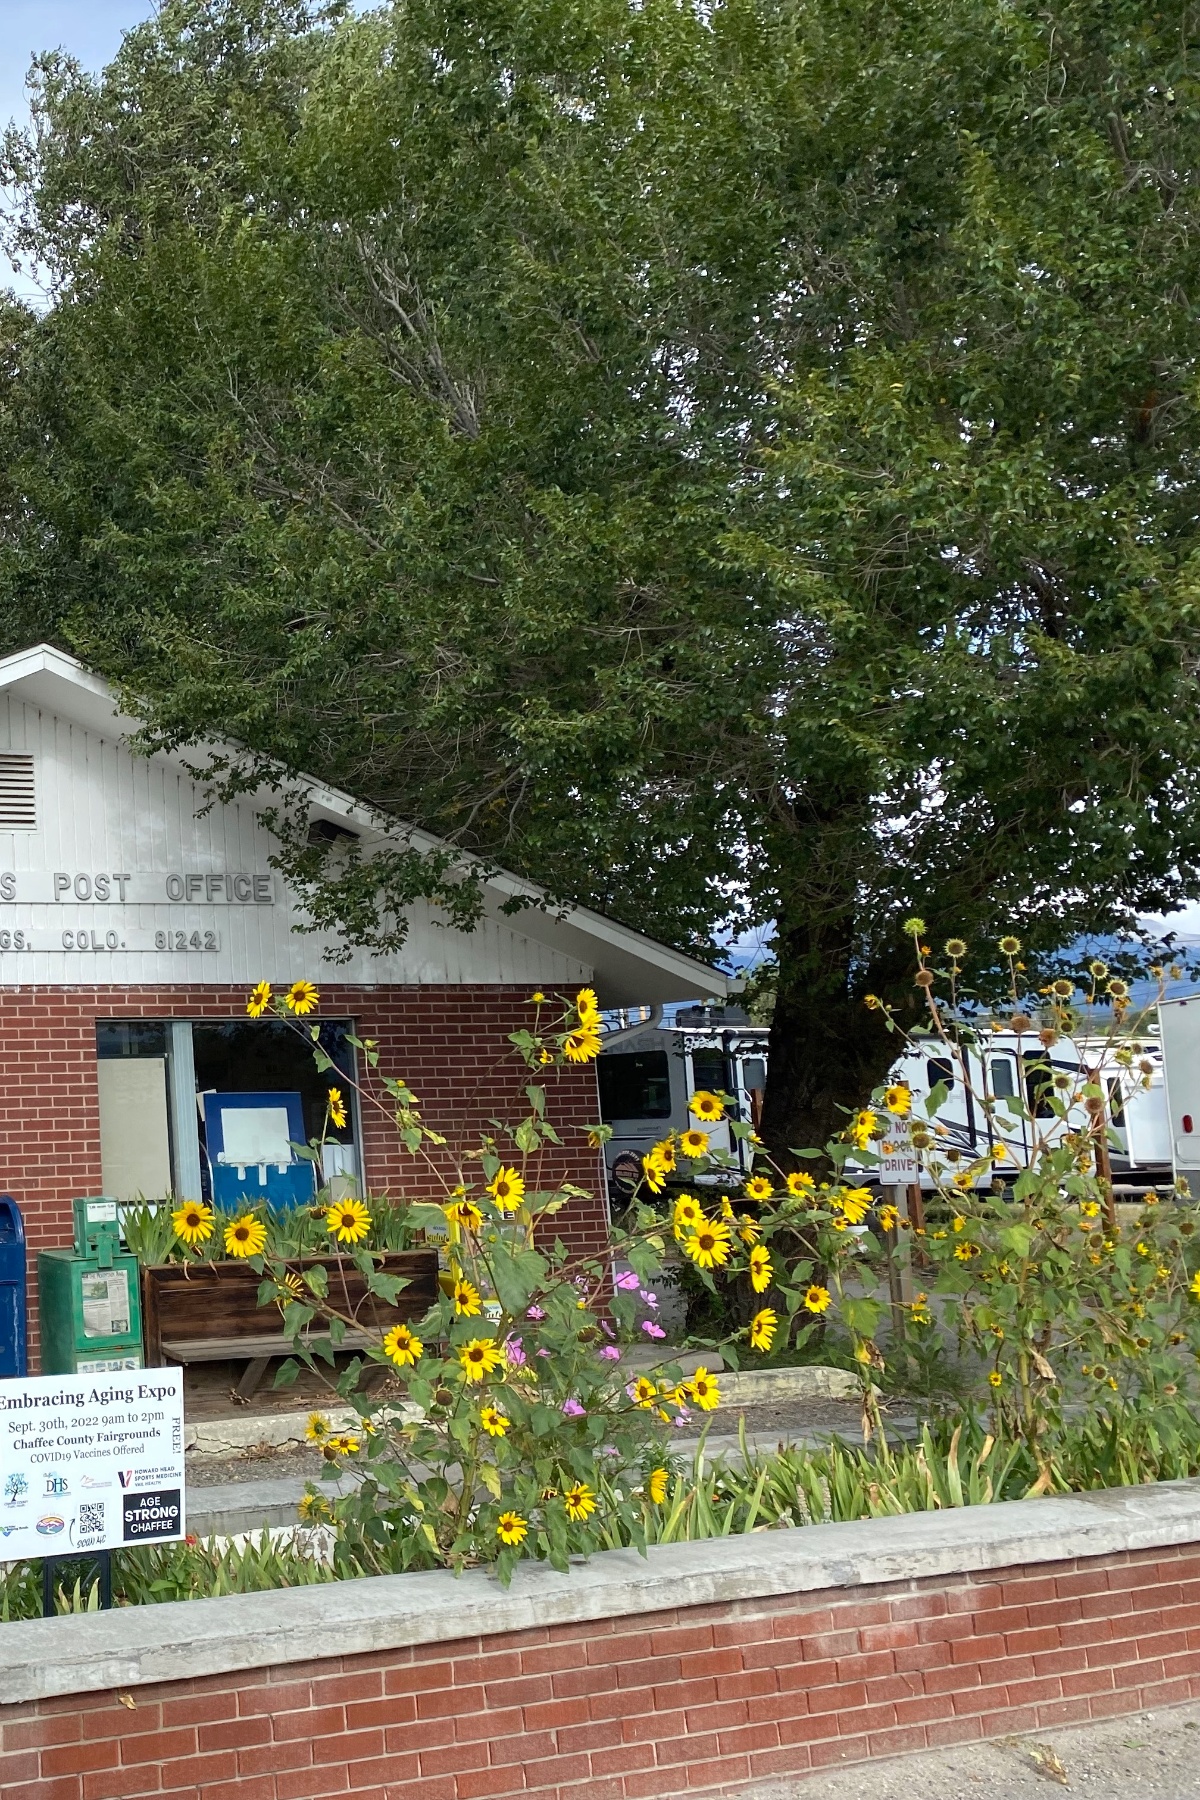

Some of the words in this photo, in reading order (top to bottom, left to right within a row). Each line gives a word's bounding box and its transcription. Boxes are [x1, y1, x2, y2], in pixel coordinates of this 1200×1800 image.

[53, 872, 131, 901] POST
[165, 873, 272, 901] OFFICE
[62, 930, 126, 950] COLO.
[154, 930, 217, 950] 81242
[885, 1159, 913, 1172] DRIVE
[82, 1360, 136, 1374] NEWS
[88, 1386, 134, 1406] Aging
[137, 1384, 176, 1401] Expo
[8, 1420, 36, 1435] Sept.
[39, 1417, 68, 1433] 30th,
[71, 1416, 99, 1428] 2022
[102, 1414, 125, 1427] 9am
[127, 1412, 139, 1423] to
[141, 1411, 164, 1424] 2pm
[13, 1437, 54, 1450] Chaffee
[56, 1434, 94, 1446] County
[96, 1427, 161, 1443] Fairgrounds
[172, 1417, 181, 1454] FREE!
[30, 1451, 71, 1464] COVID19
[73, 1447, 111, 1459] Vaccines
[113, 1443, 145, 1456] Offered
[134, 1467, 159, 1475] HOWARD
[46, 1478, 68, 1493] DHS
[140, 1496, 161, 1507] AGE
[124, 1505, 179, 1522] STRONG
[130, 1520, 174, 1534] CHAFFEE
